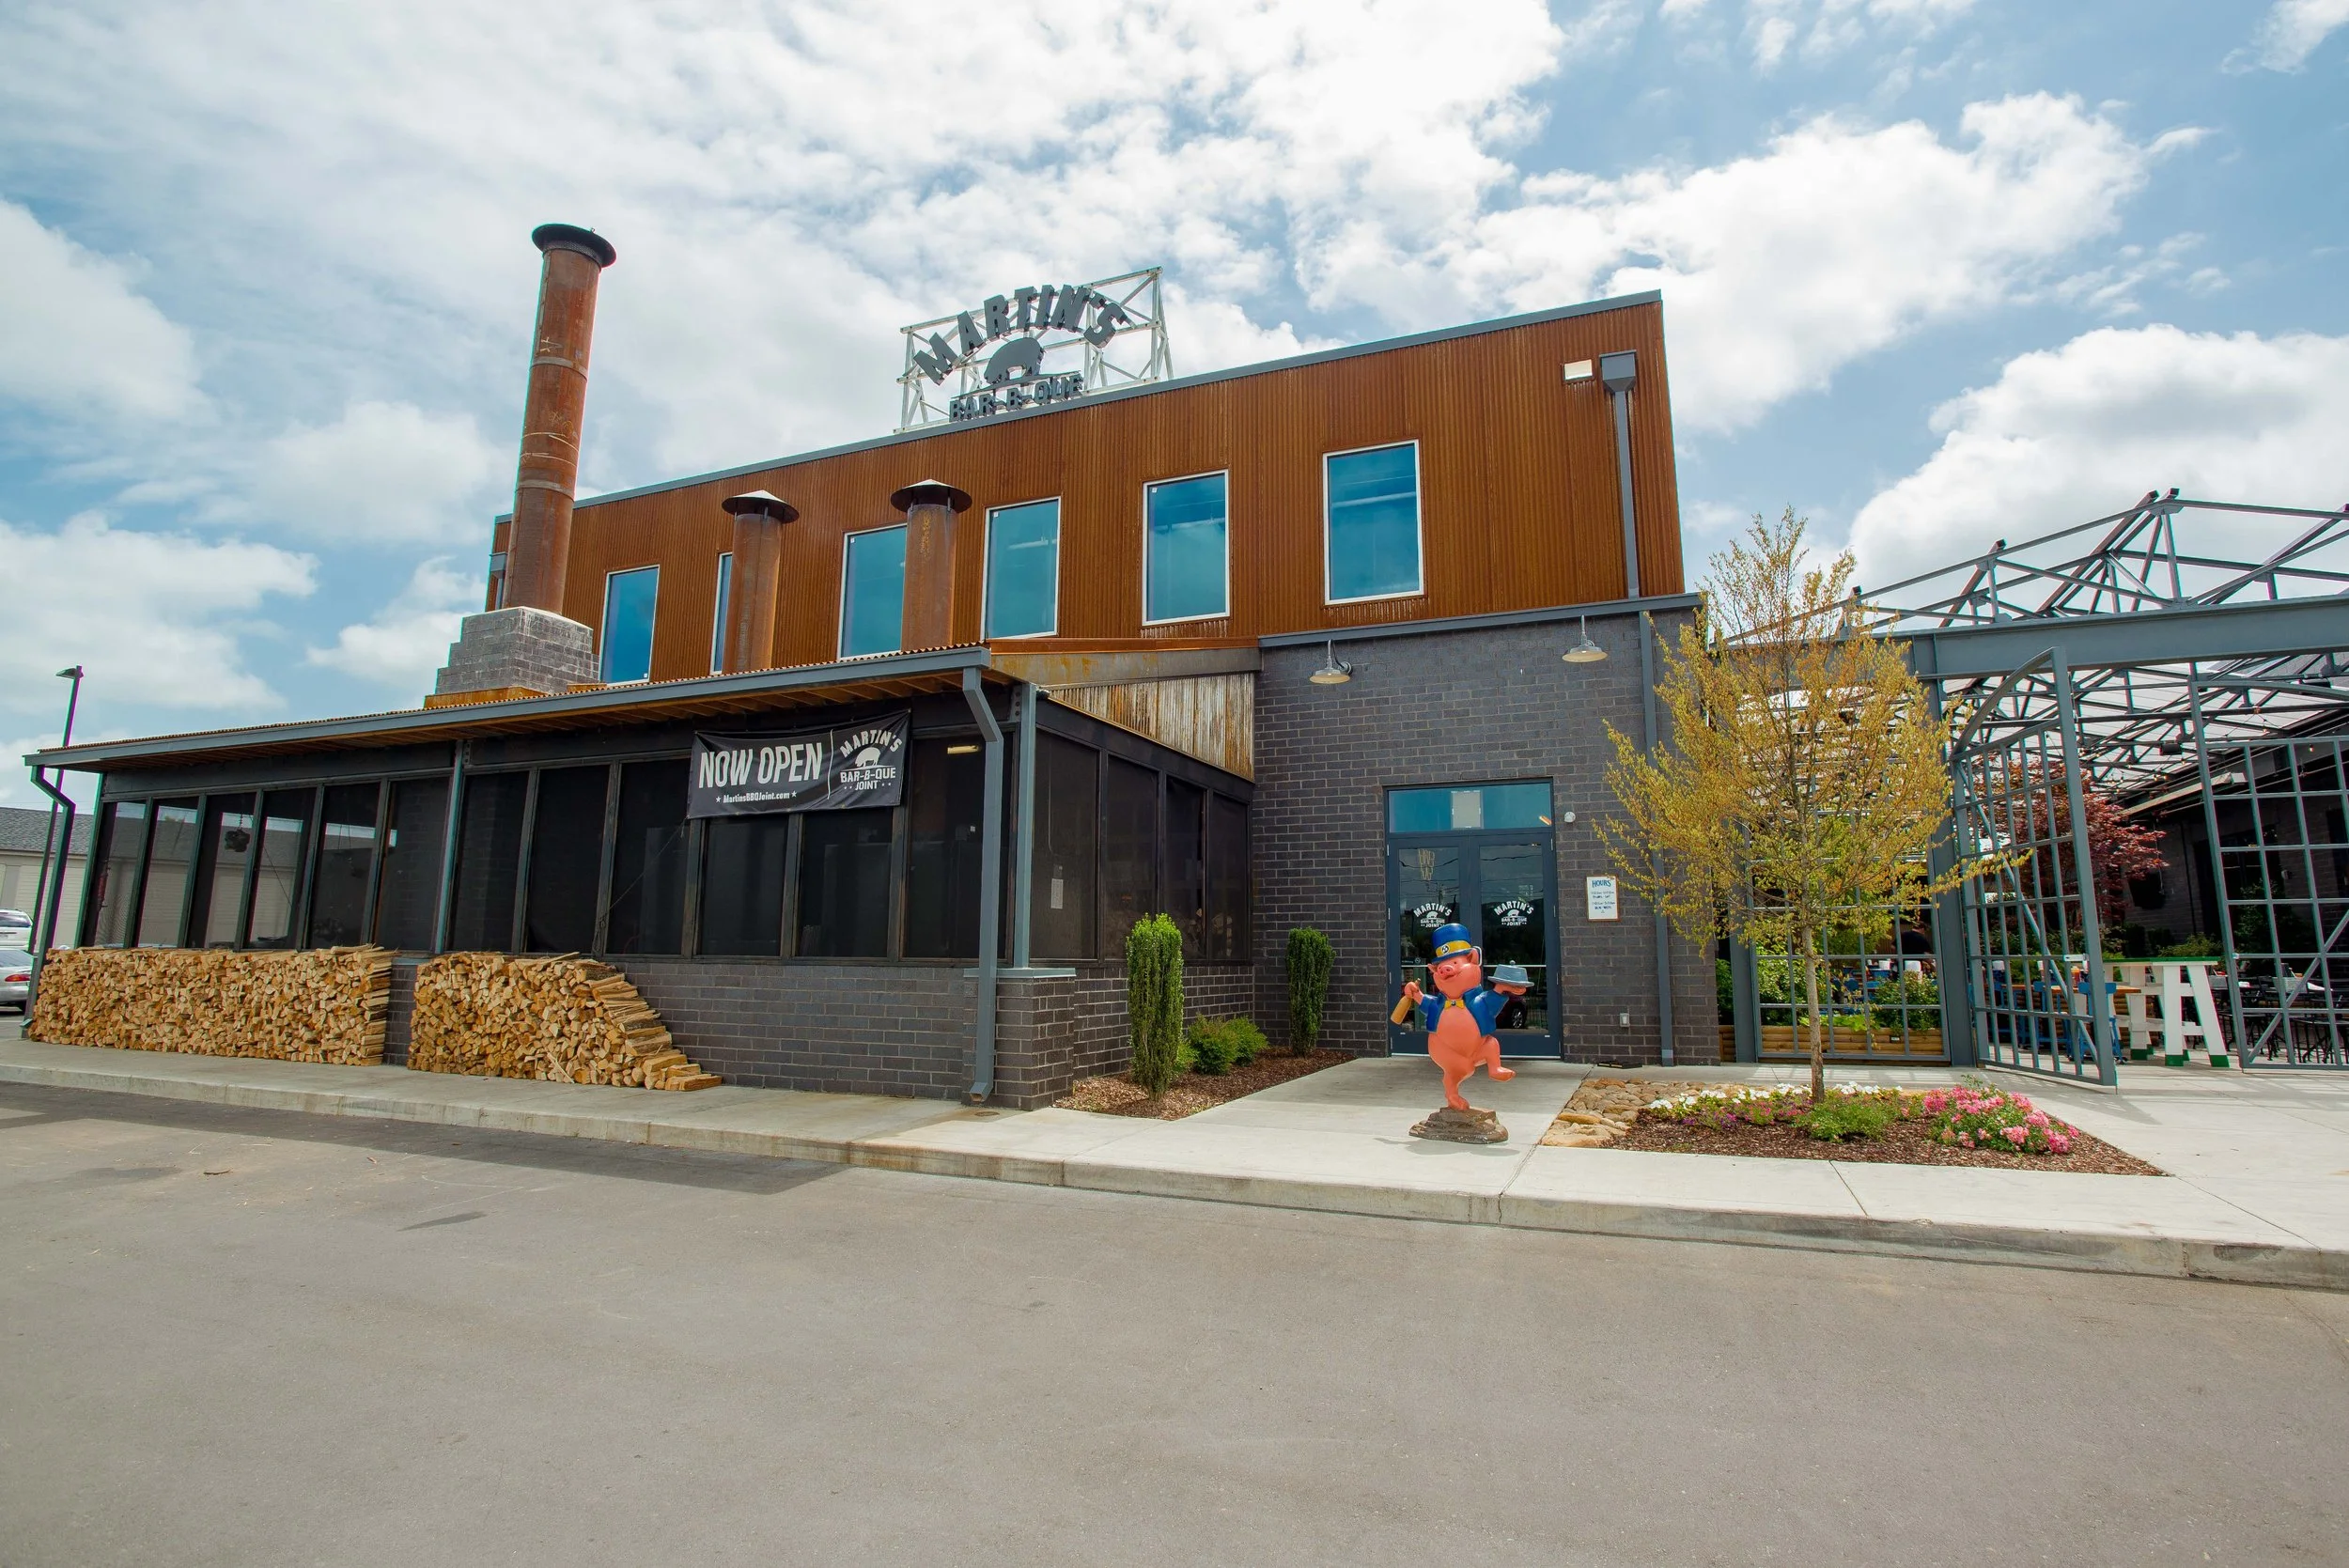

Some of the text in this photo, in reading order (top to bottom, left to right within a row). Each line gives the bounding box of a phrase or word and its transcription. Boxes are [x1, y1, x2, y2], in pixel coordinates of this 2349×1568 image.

[913, 284, 1128, 385] MARTIN'S
[949, 376, 1083, 422] BAR-B-QUE
[839, 729, 903, 758] MARTIN'S
[698, 742, 823, 788] NOW OPEN
[840, 768, 896, 783] BAR-B-QUE
[855, 781, 879, 791] JOINT
[723, 792, 790, 803] MartinsBBQJoint.com
[1592, 879, 1611, 888] HOURS
[1413, 903, 1452, 917] MARTIN'S
[1494, 900, 1534, 915] MARTIN'S
